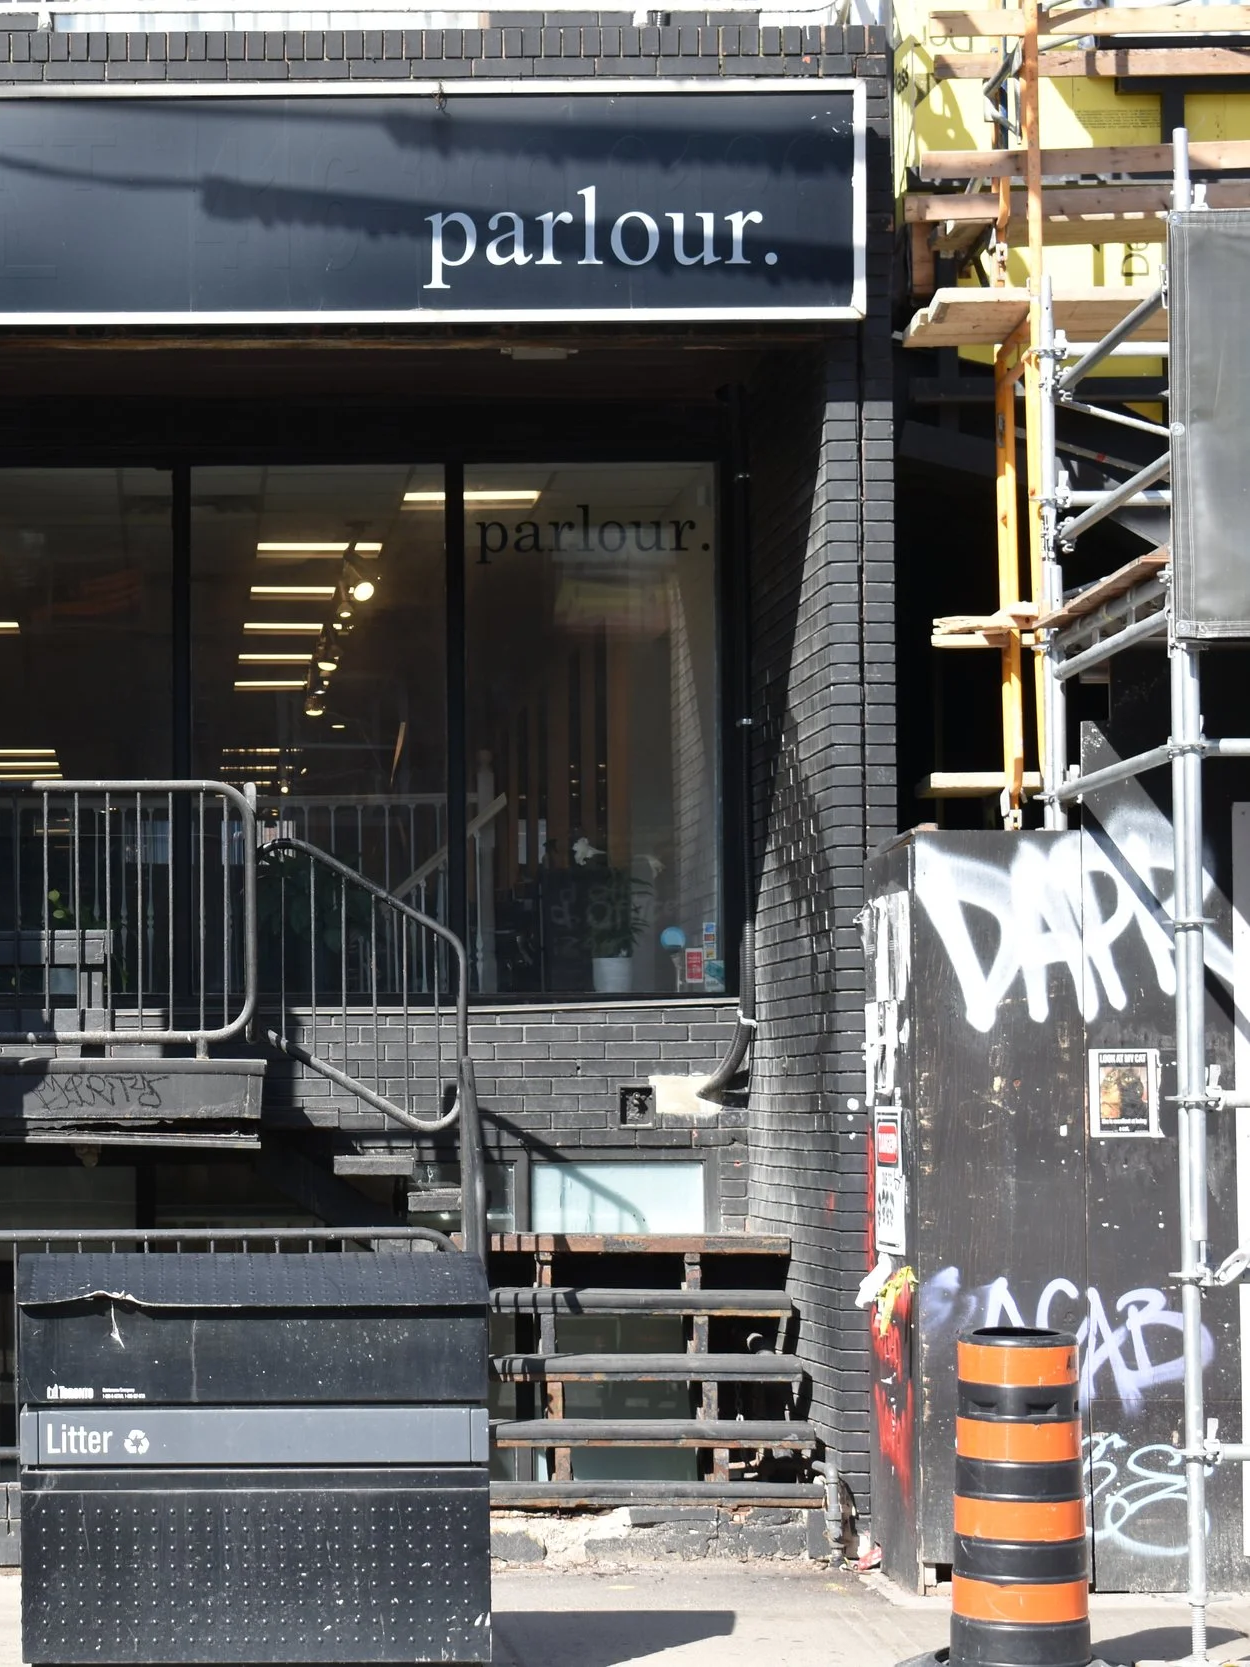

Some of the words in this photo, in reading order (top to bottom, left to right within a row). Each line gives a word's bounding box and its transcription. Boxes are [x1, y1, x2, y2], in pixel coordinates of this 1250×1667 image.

[423, 185, 778, 289] parlour.
[476, 505, 711, 564] parlour.
[1135, 1054, 1146, 1063] CAT
[47, 1423, 113, 1454] Litter
